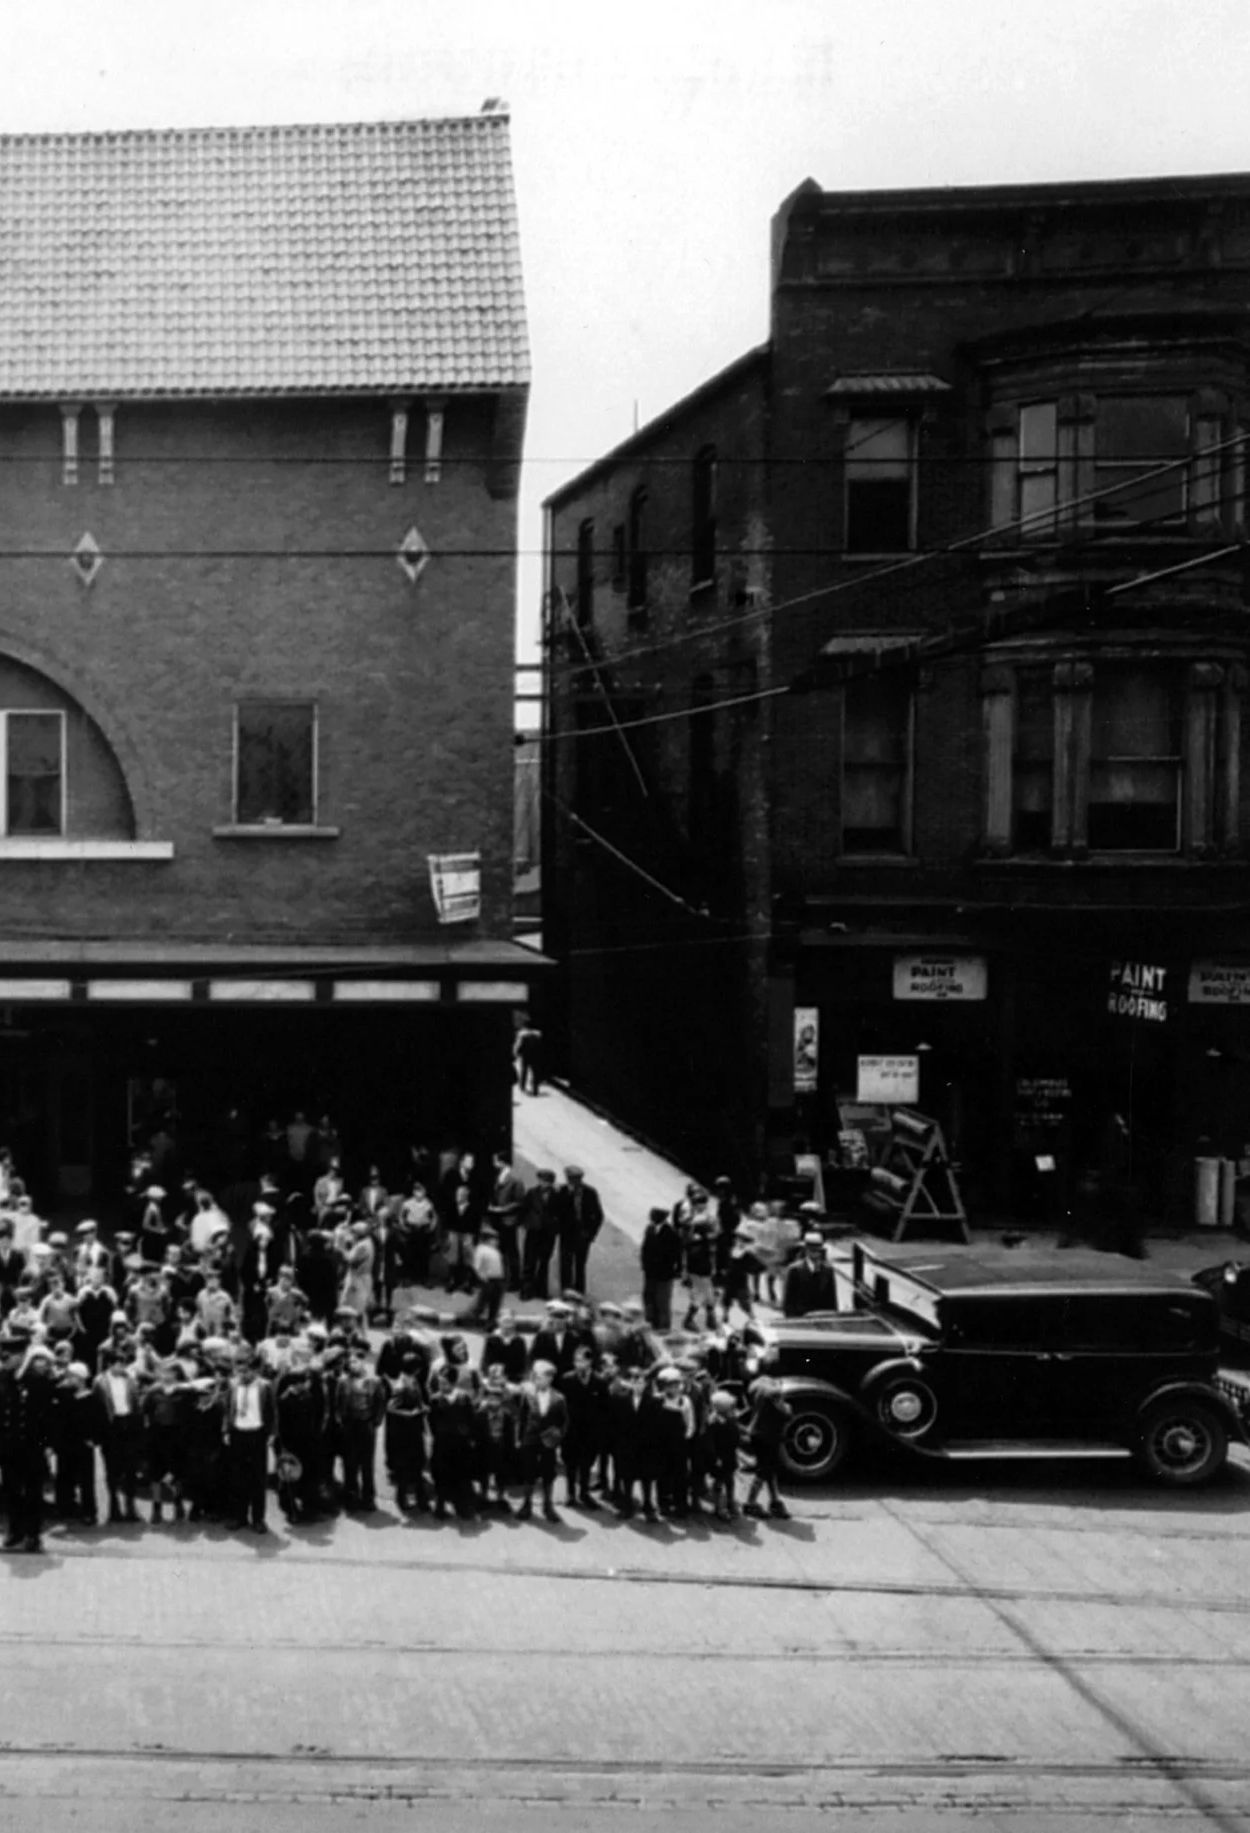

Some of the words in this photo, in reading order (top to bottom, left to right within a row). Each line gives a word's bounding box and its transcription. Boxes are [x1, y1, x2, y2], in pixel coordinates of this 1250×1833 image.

[910, 966, 955, 977] PAINT
[1110, 960, 1166, 991] PAINT
[1107, 992, 1167, 1021] ROOFING
